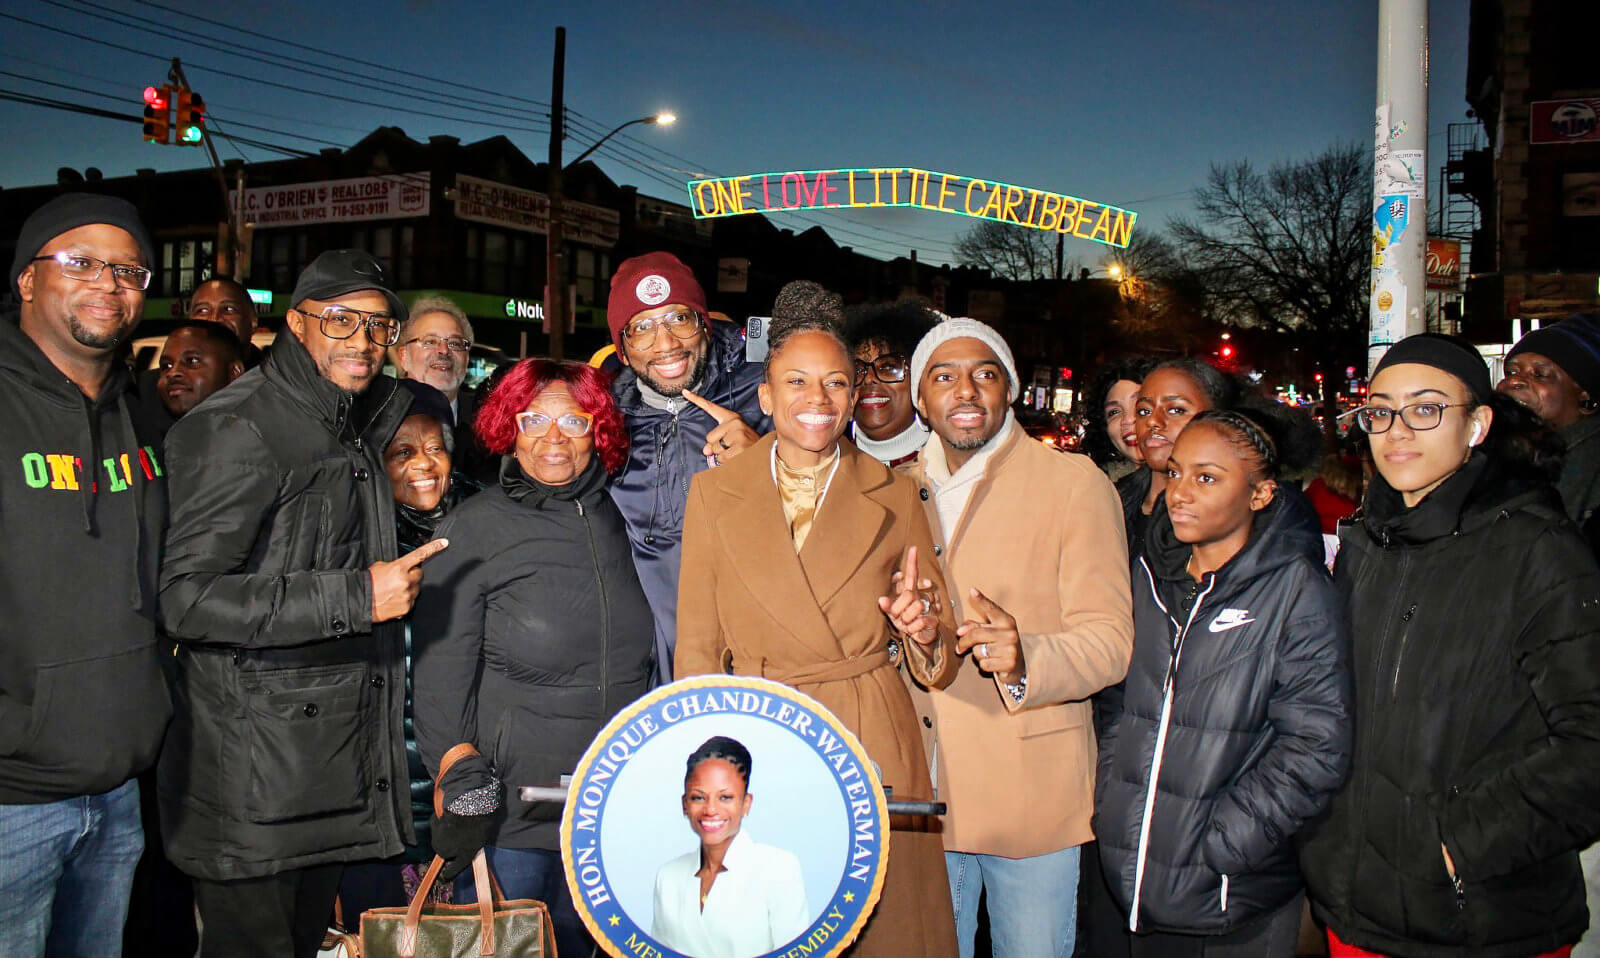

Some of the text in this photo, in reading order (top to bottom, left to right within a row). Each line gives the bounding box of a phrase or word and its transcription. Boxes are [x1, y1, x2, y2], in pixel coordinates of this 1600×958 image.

[264, 188, 317, 211] O'BRIEN
[331, 181, 389, 200] REALTORS
[302, 206, 328, 219] OFFICE
[696, 169, 1137, 249] ONE LOVE LITTLE CARIBBEAN
[1426, 252, 1456, 276] Deli
[22, 452, 97, 493] ON
[577, 690, 875, 908] HON. MONIQUE CHANDLER-WATERMAN
[624, 905, 846, 958] ME EMBLY
